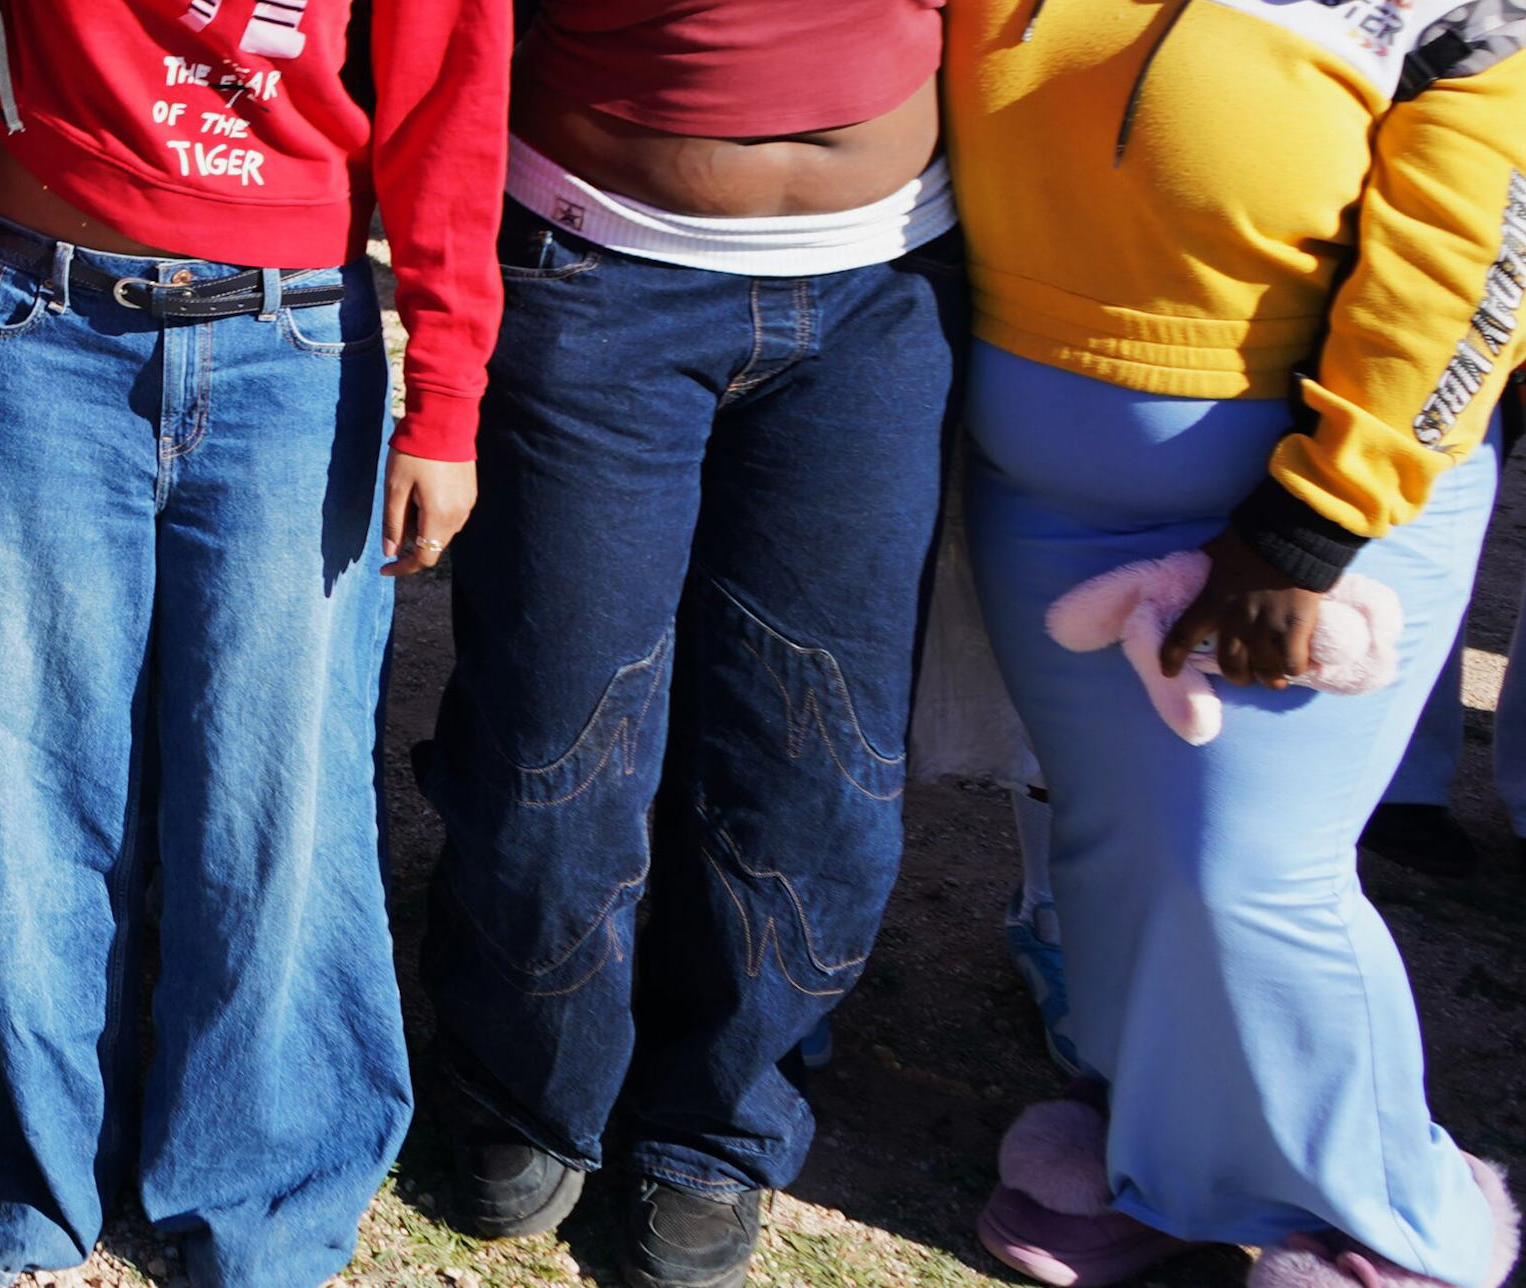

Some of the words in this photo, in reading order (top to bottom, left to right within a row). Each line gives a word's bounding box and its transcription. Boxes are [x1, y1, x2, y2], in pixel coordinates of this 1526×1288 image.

[163, 55, 211, 87] THE
[152, 100, 187, 127] OF
[200, 112, 250, 139] THE
[166, 140, 265, 187] TIGER
